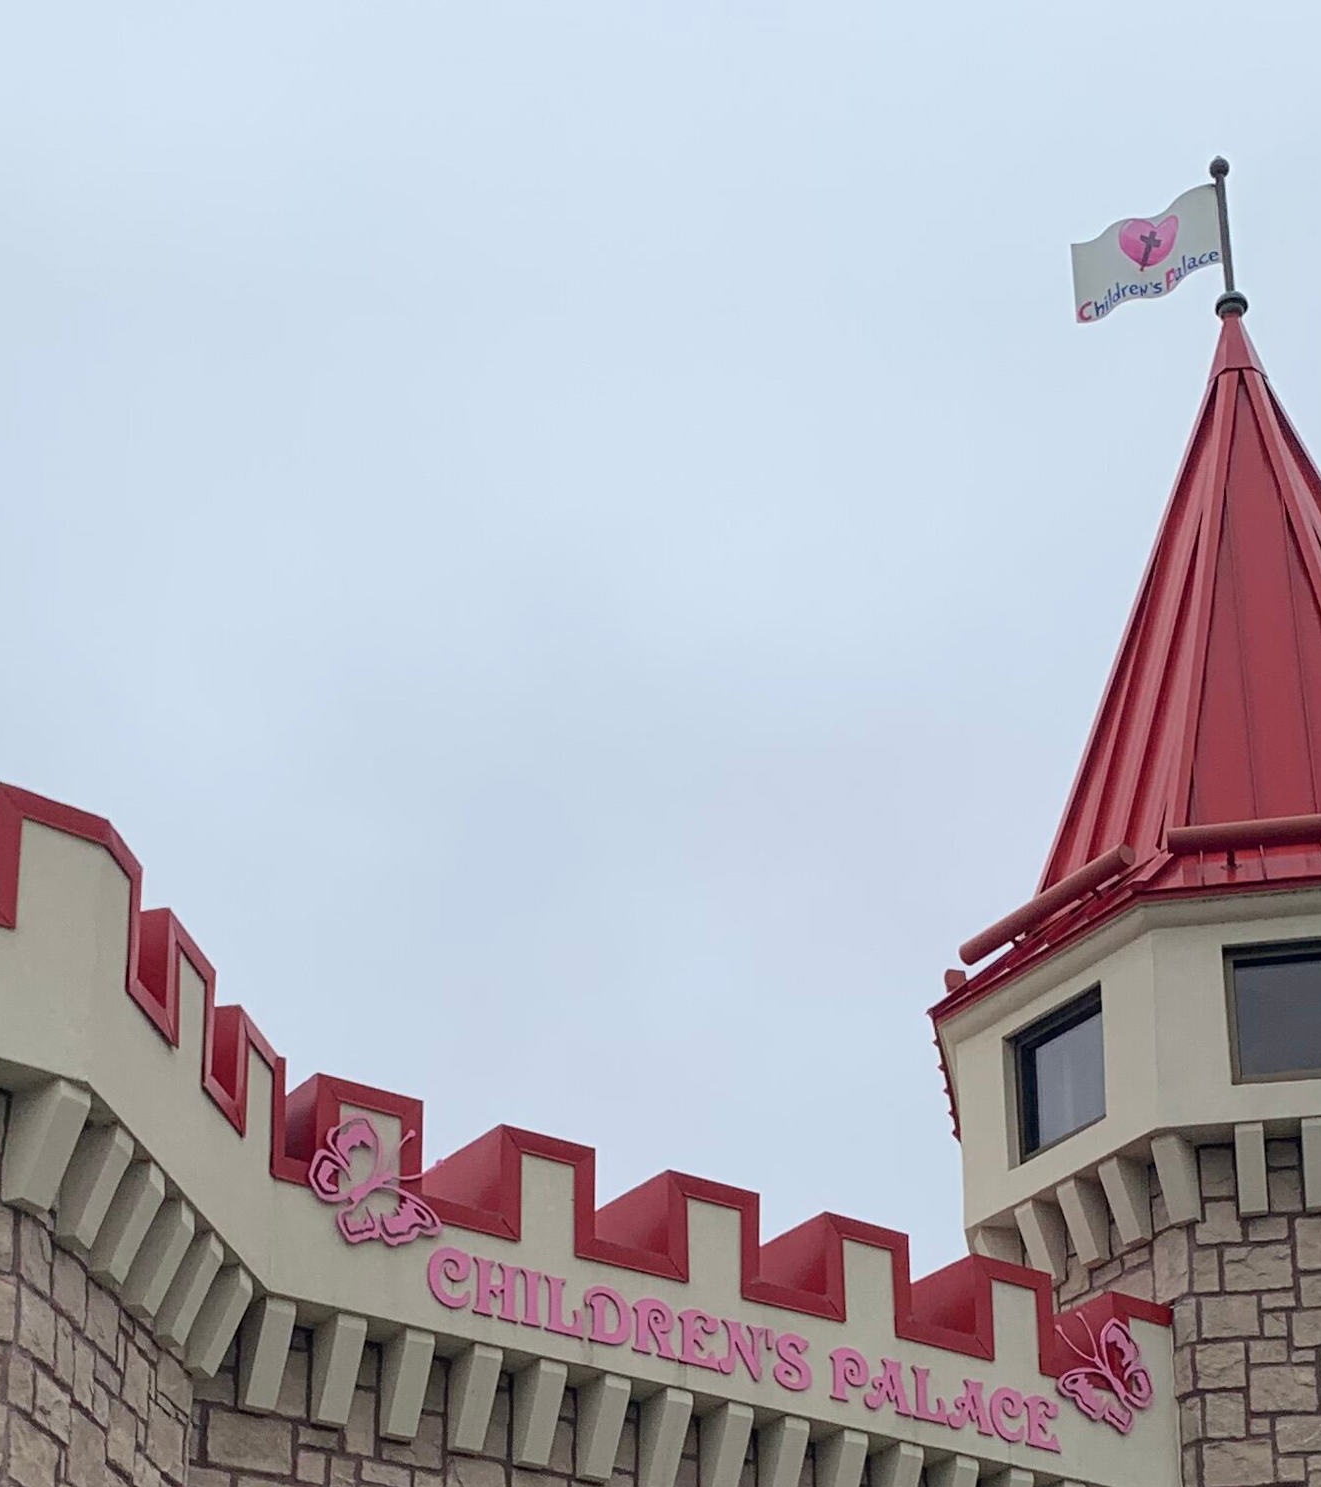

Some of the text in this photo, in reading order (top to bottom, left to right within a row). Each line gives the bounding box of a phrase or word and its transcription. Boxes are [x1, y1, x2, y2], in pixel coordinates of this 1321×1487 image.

[1078, 250, 1219, 321] Children's Palace
[427, 1246, 1062, 1453] CHILDREN'S PALACE
